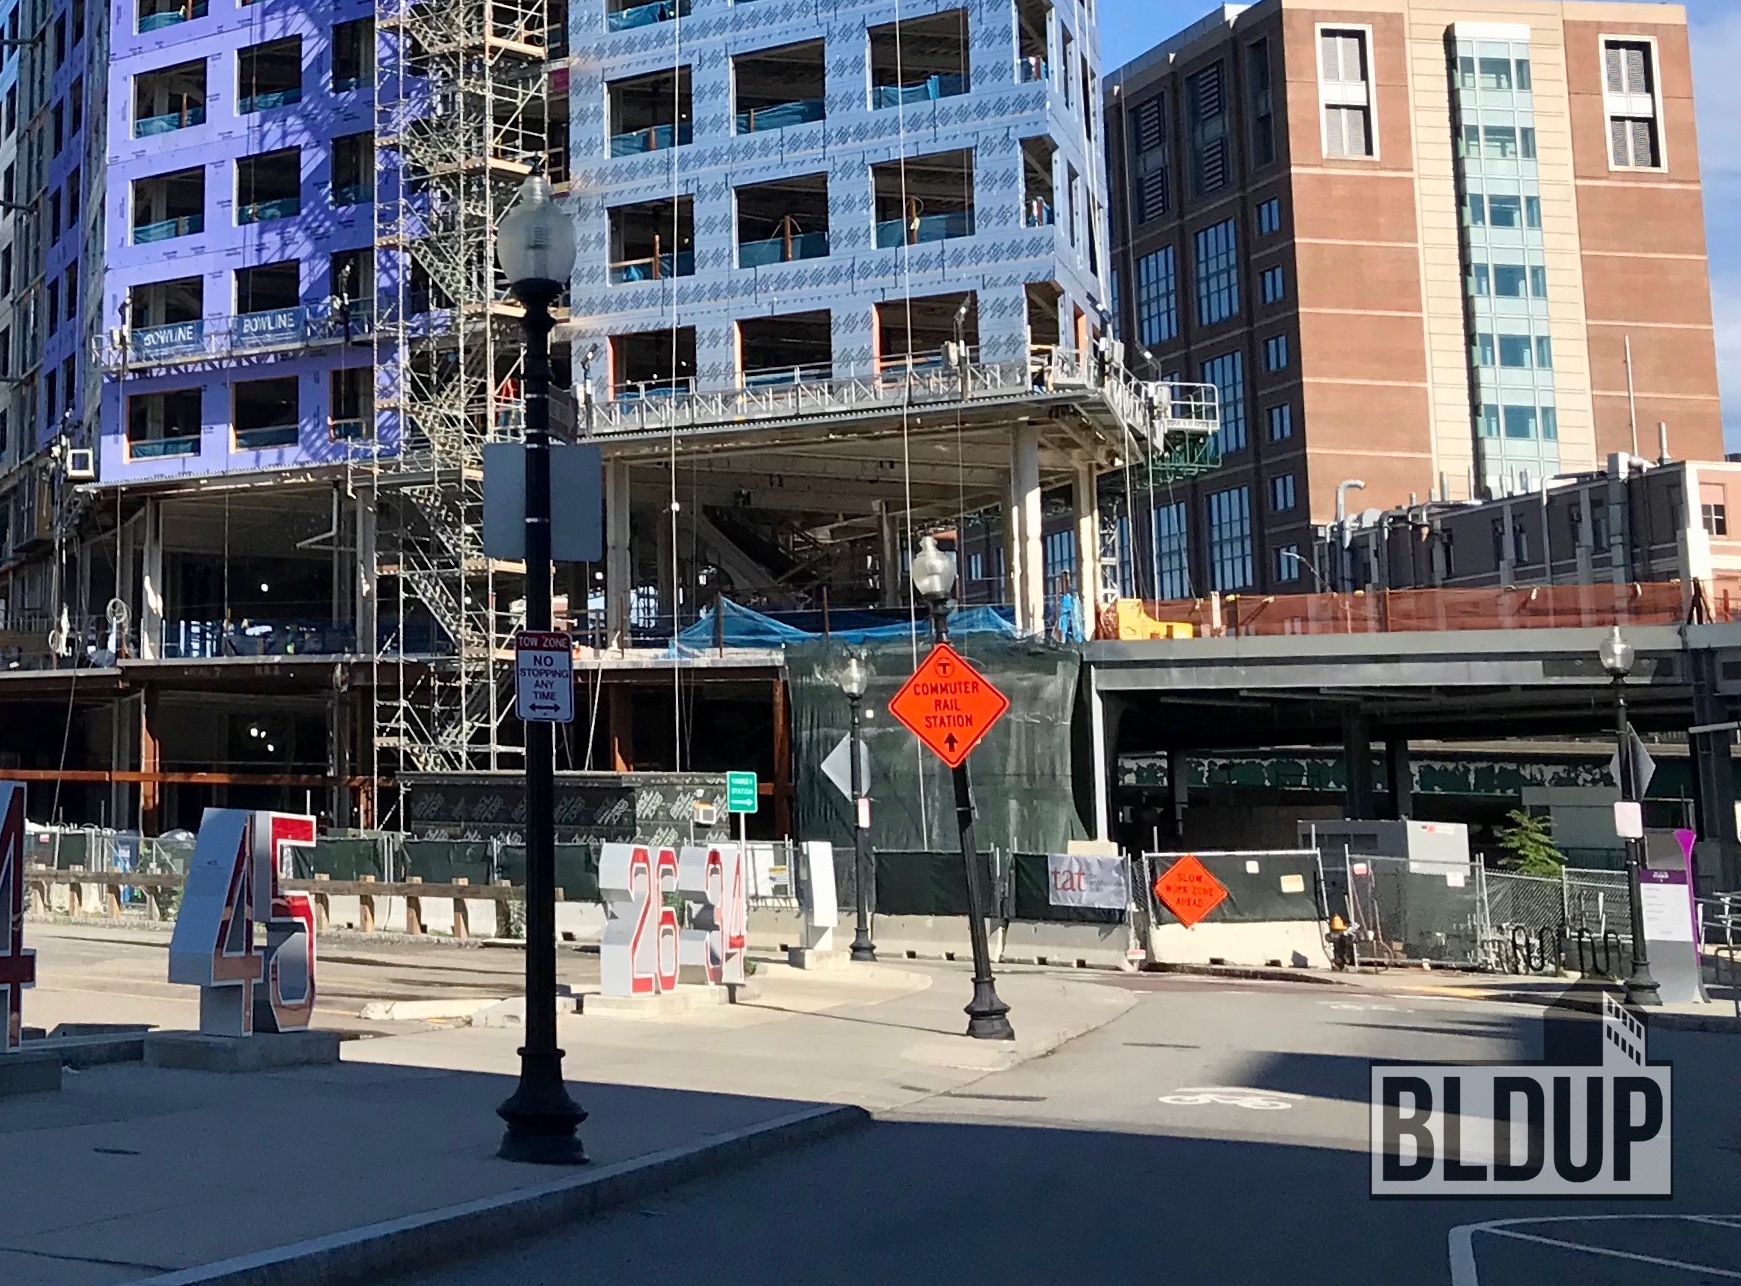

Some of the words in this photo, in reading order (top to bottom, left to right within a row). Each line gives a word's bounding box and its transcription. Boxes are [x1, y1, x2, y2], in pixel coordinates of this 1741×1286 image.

[242, 312, 295, 333] BOWLINE
[519, 636, 538, 647] TOW
[543, 637, 568, 648] ZONE
[533, 655, 554, 667] NO
[520, 668, 569, 679] STOPPING
[937, 662, 951, 675] T
[534, 680, 554, 689] ANY
[913, 681, 980, 696] COMMUTER
[533, 691, 557, 701] TIME
[934, 699, 961, 712] RAIL
[924, 715, 974, 729] STATION
[1051, 866, 1087, 892] tat
[1177, 872, 1203, 883] SLOW
[1176, 897, 1204, 908] AHEAD
[210, 810, 317, 1038] 45
[628, 845, 679, 996] 26
